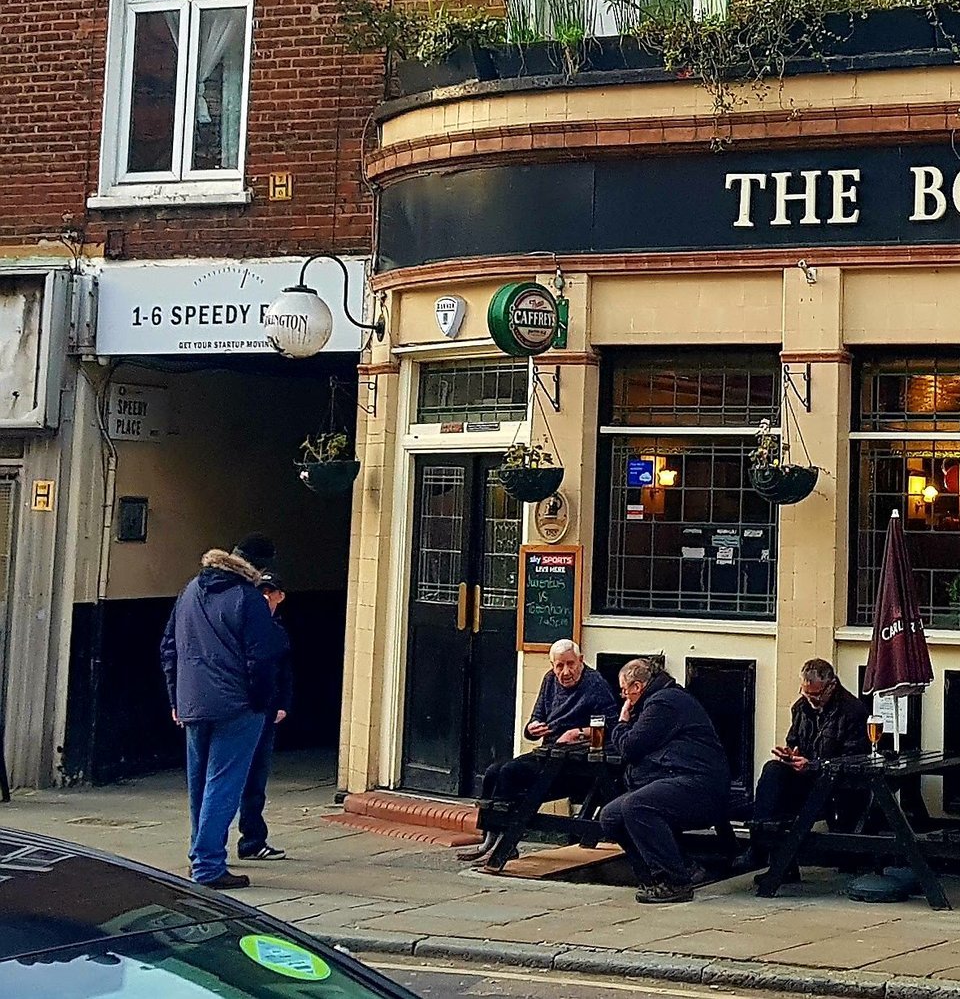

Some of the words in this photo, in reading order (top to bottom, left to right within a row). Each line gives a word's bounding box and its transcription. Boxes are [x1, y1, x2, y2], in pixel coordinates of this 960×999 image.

[725, 168, 861, 228] THE
[132, 306, 162, 327] 1-6
[170, 303, 251, 326] SPEEDY
[178, 341, 193, 349] GET
[194, 341, 212, 349] YOUR
[213, 340, 245, 349] STARTUP
[117, 399, 148, 417] SPEEDY
[116, 418, 141, 436] PLACE
[529, 555, 542, 565] sky
[543, 556, 572, 565] SPORTS
